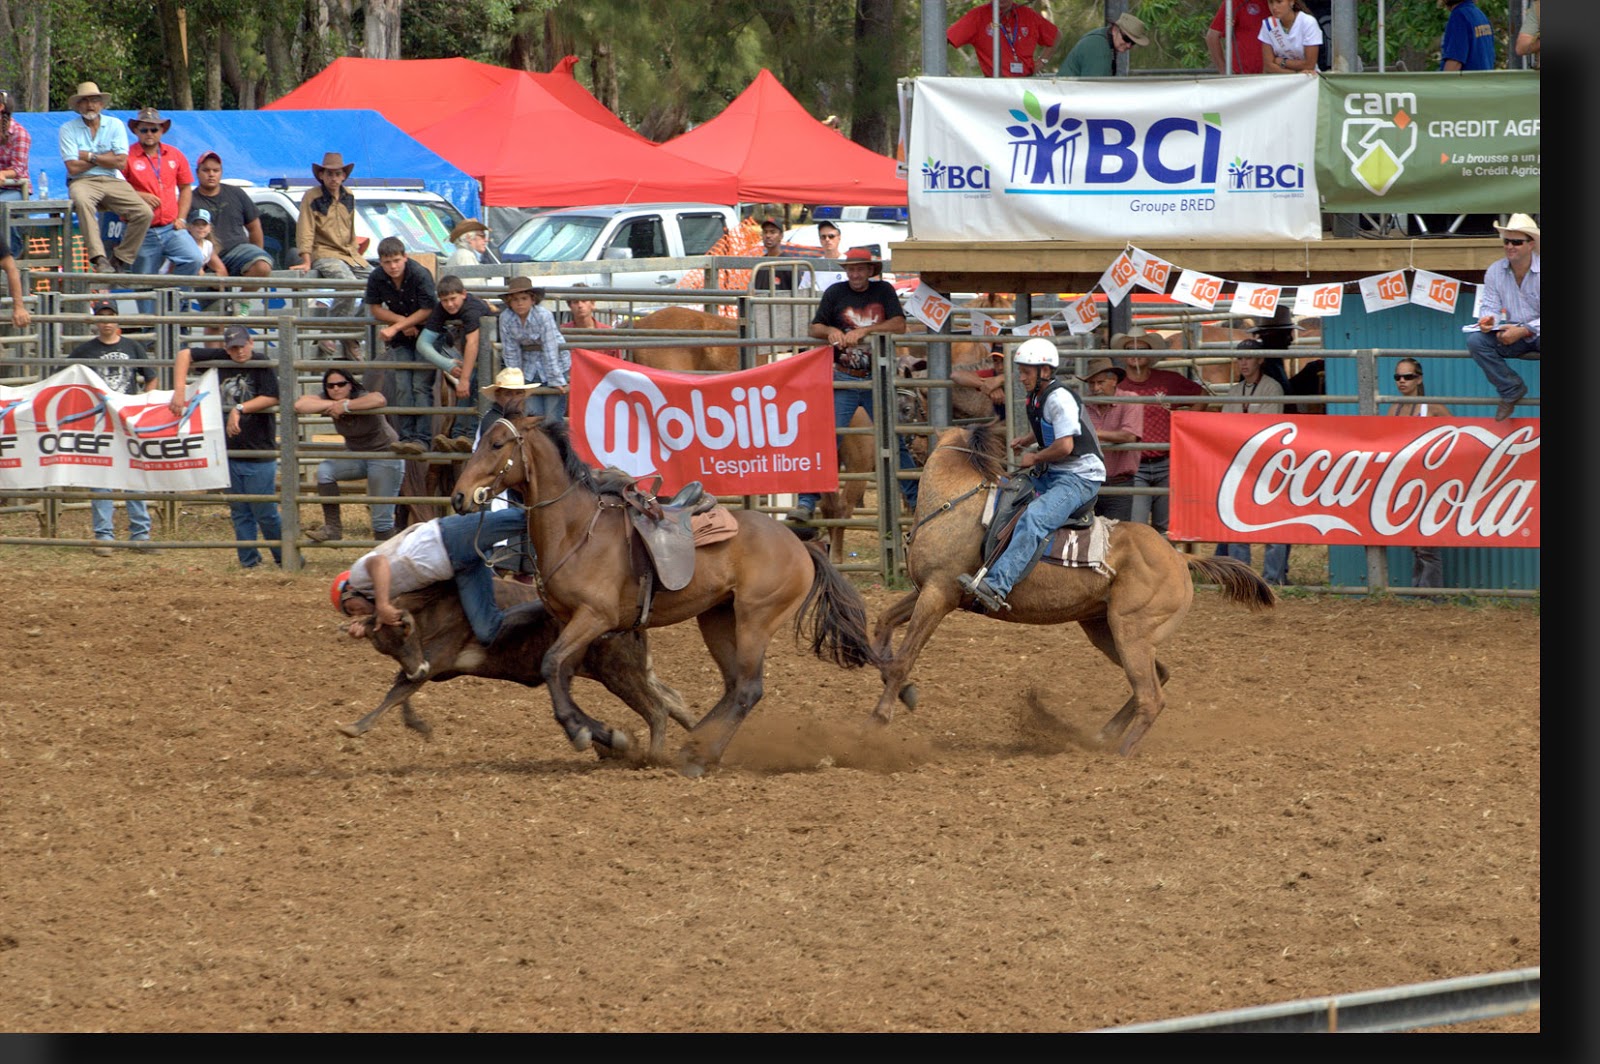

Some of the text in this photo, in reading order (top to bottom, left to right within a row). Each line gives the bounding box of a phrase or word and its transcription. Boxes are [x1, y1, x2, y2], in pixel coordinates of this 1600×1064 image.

[1344, 92, 1418, 115] cam
[1428, 120, 1500, 138] CREDIT
[1084, 112, 1222, 184] BCI
[1451, 153, 1463, 164] La
[1466, 153, 1509, 163] brousse
[1511, 154, 1519, 163] a
[1521, 153, 1535, 162] un
[947, 164, 991, 189] BCI
[1255, 162, 1304, 189] BCI
[1462, 165, 1540, 178] le Crédit Agric
[1129, 198, 1216, 215] Groupe BRED
[107, 220, 123, 239] 80
[1112, 261, 1133, 286] rfo
[1143, 264, 1167, 284] rfo
[1192, 280, 1218, 300] rfo
[1314, 289, 1340, 306] rfo
[1380, 278, 1404, 298] rfo
[1430, 281, 1455, 301] rfo
[1250, 290, 1276, 307] rfo
[923, 298, 947, 321] rfo
[1077, 302, 1098, 321] rfo
[585, 368, 808, 478] Mobilis
[38, 432, 114, 455] OCEF
[126, 435, 205, 460] OCEF
[699, 454, 769, 478] L'esprit
[773, 453, 811, 472] libre
[1217, 421, 1540, 537] Coca-Cola
